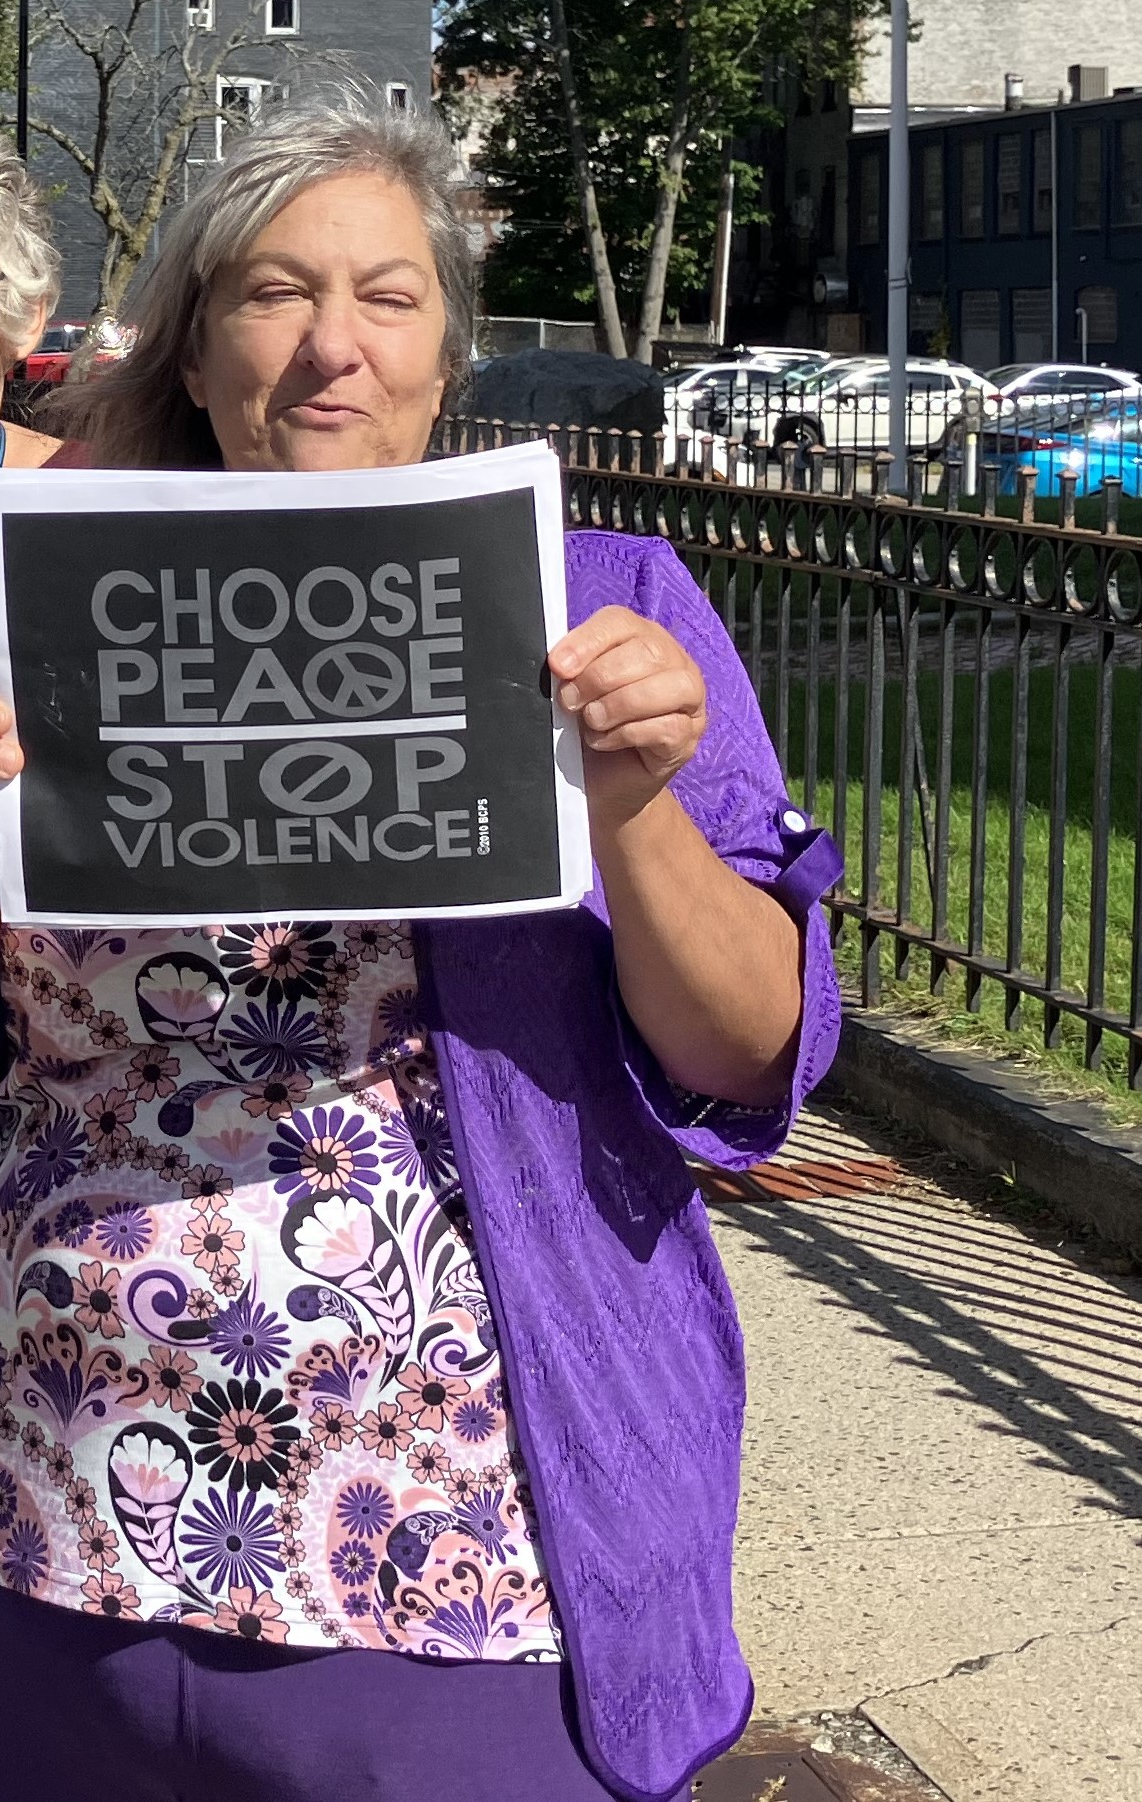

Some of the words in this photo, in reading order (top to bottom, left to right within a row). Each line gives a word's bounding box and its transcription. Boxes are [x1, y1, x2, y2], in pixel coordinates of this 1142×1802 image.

[90, 557, 463, 645] CHOOSE
[102, 809, 473, 868] VIOLENCE
[477, 798, 489, 824] BCPS
